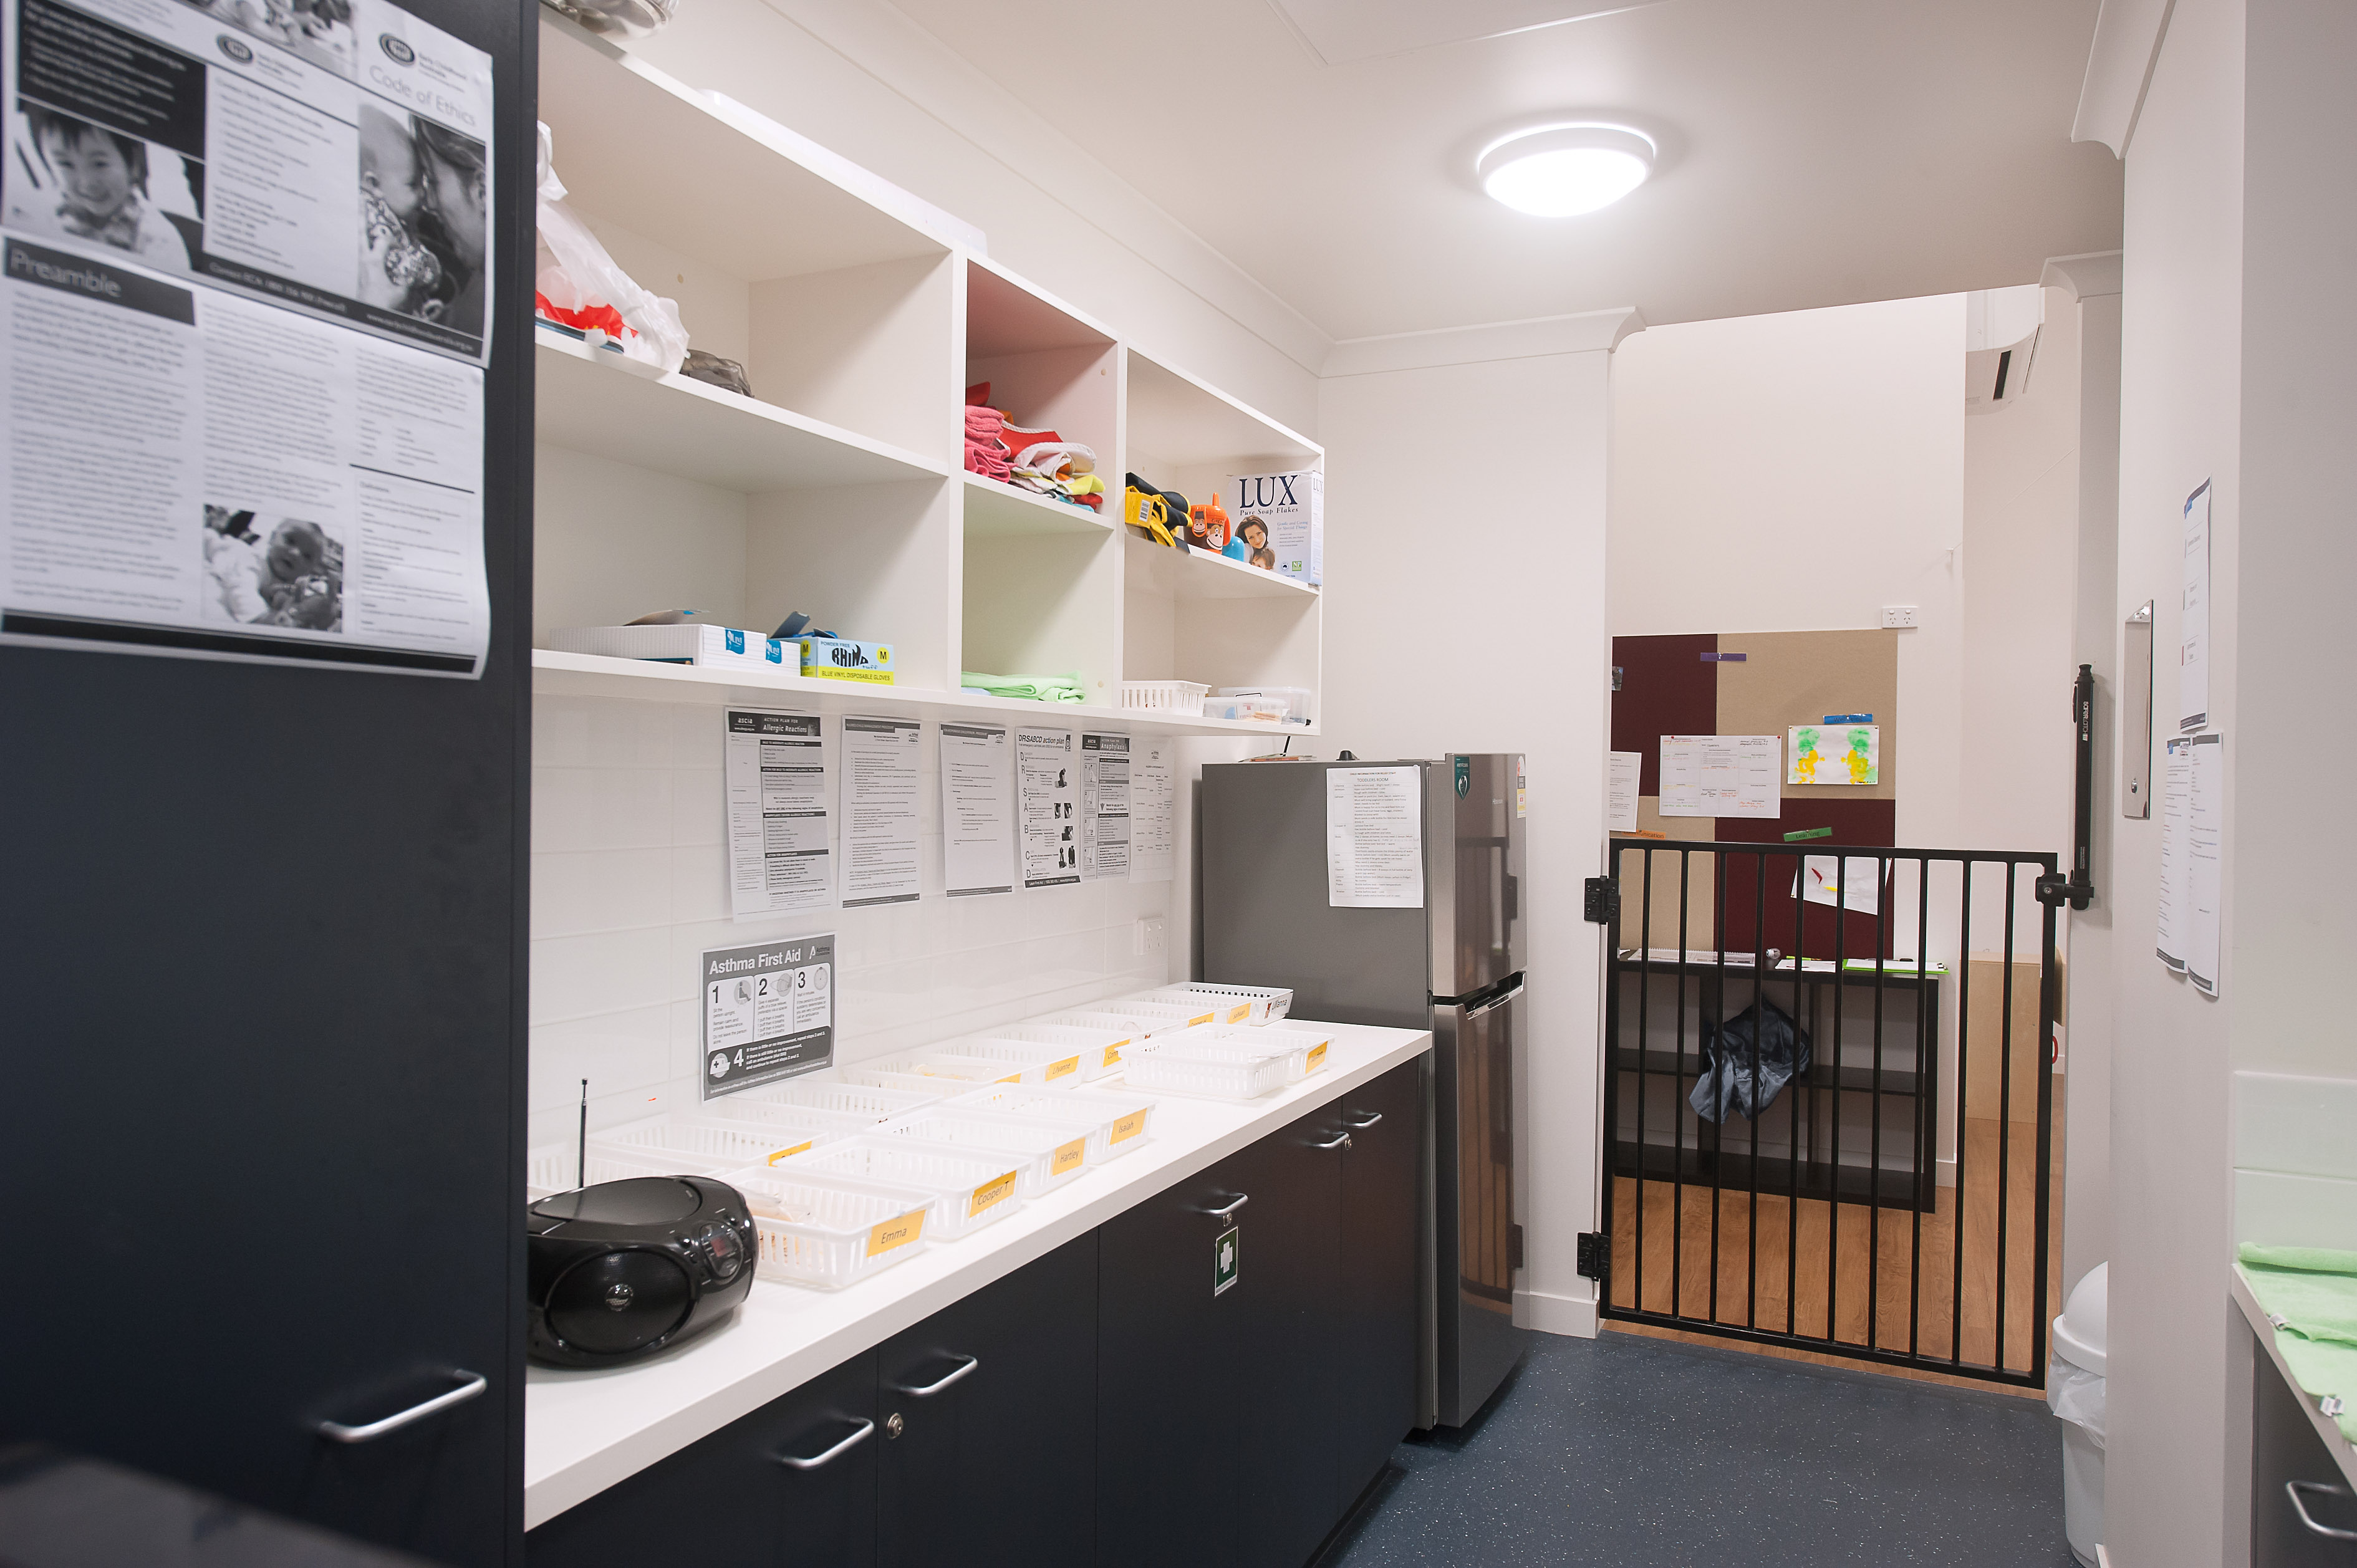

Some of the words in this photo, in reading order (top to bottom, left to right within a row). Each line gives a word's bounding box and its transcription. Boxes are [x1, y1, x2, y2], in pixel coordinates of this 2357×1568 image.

[370, 65, 411, 97] Code
[417, 91, 432, 104] of
[437, 95, 475, 127] Ethics
[11, 248, 122, 297] Preamble
[1240, 475, 1298, 508] LUX
[1313, 478, 1323, 493] LUX
[803, 644, 808, 654] M
[832, 644, 869, 667] RHINO
[880, 651, 887, 660] M
[763, 724, 784, 733] Allergic
[1021, 752, 1024, 760] D
[1022, 765, 1025, 774] R
[1023, 788, 1027, 796] S
[1024, 803, 1028, 812] A
[1024, 825, 1028, 833] B
[1026, 851, 1029, 860] C
[1027, 870, 1031, 878] D
[709, 958, 754, 974] Asthma
[758, 951, 783, 967] First
[784, 948, 801, 963] Aid
[758, 978, 768, 996] 2
[798, 971, 806, 988] 3
[713, 986, 718, 1003] 1
[734, 1049, 744, 1067] 4
[1053, 1063, 1071, 1074] Lilyanne
[1119, 1120, 1134, 1133] Isaiah
[1060, 1149, 1080, 1164] Hartley
[977, 1186, 1003, 1206] Cooper
[1005, 1180, 1010, 1193] T
[881, 1226, 907, 1244] Emma
